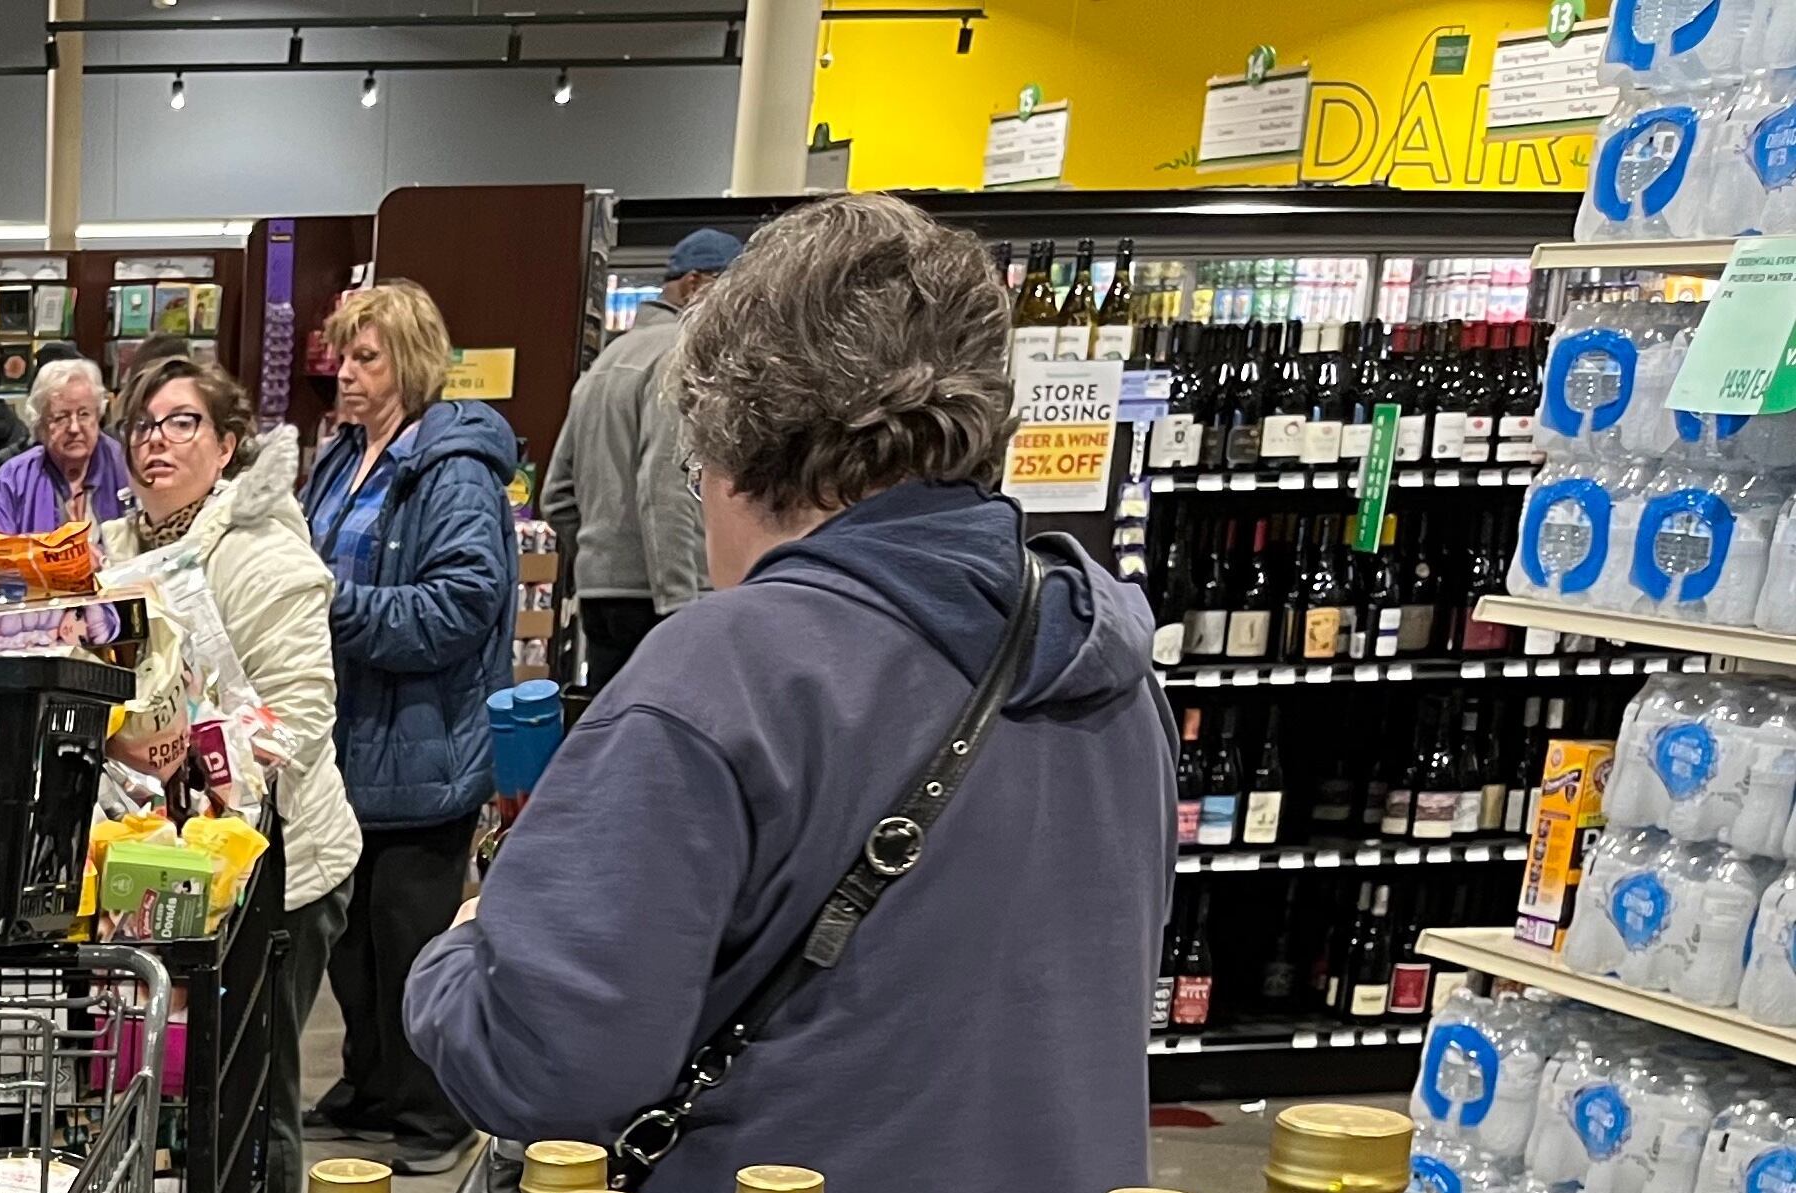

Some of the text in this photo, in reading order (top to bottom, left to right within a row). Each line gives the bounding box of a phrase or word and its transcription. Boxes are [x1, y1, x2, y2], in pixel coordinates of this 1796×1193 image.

[1550, 2, 1573, 34] 13
[1032, 383, 1099, 402] STORE
[1020, 404, 1112, 422] CLOSING
[1013, 431, 1109, 449] BEER & WINE
[1013, 453, 1103, 475] 25% OFF
[161, 897, 177, 938] Donuts
